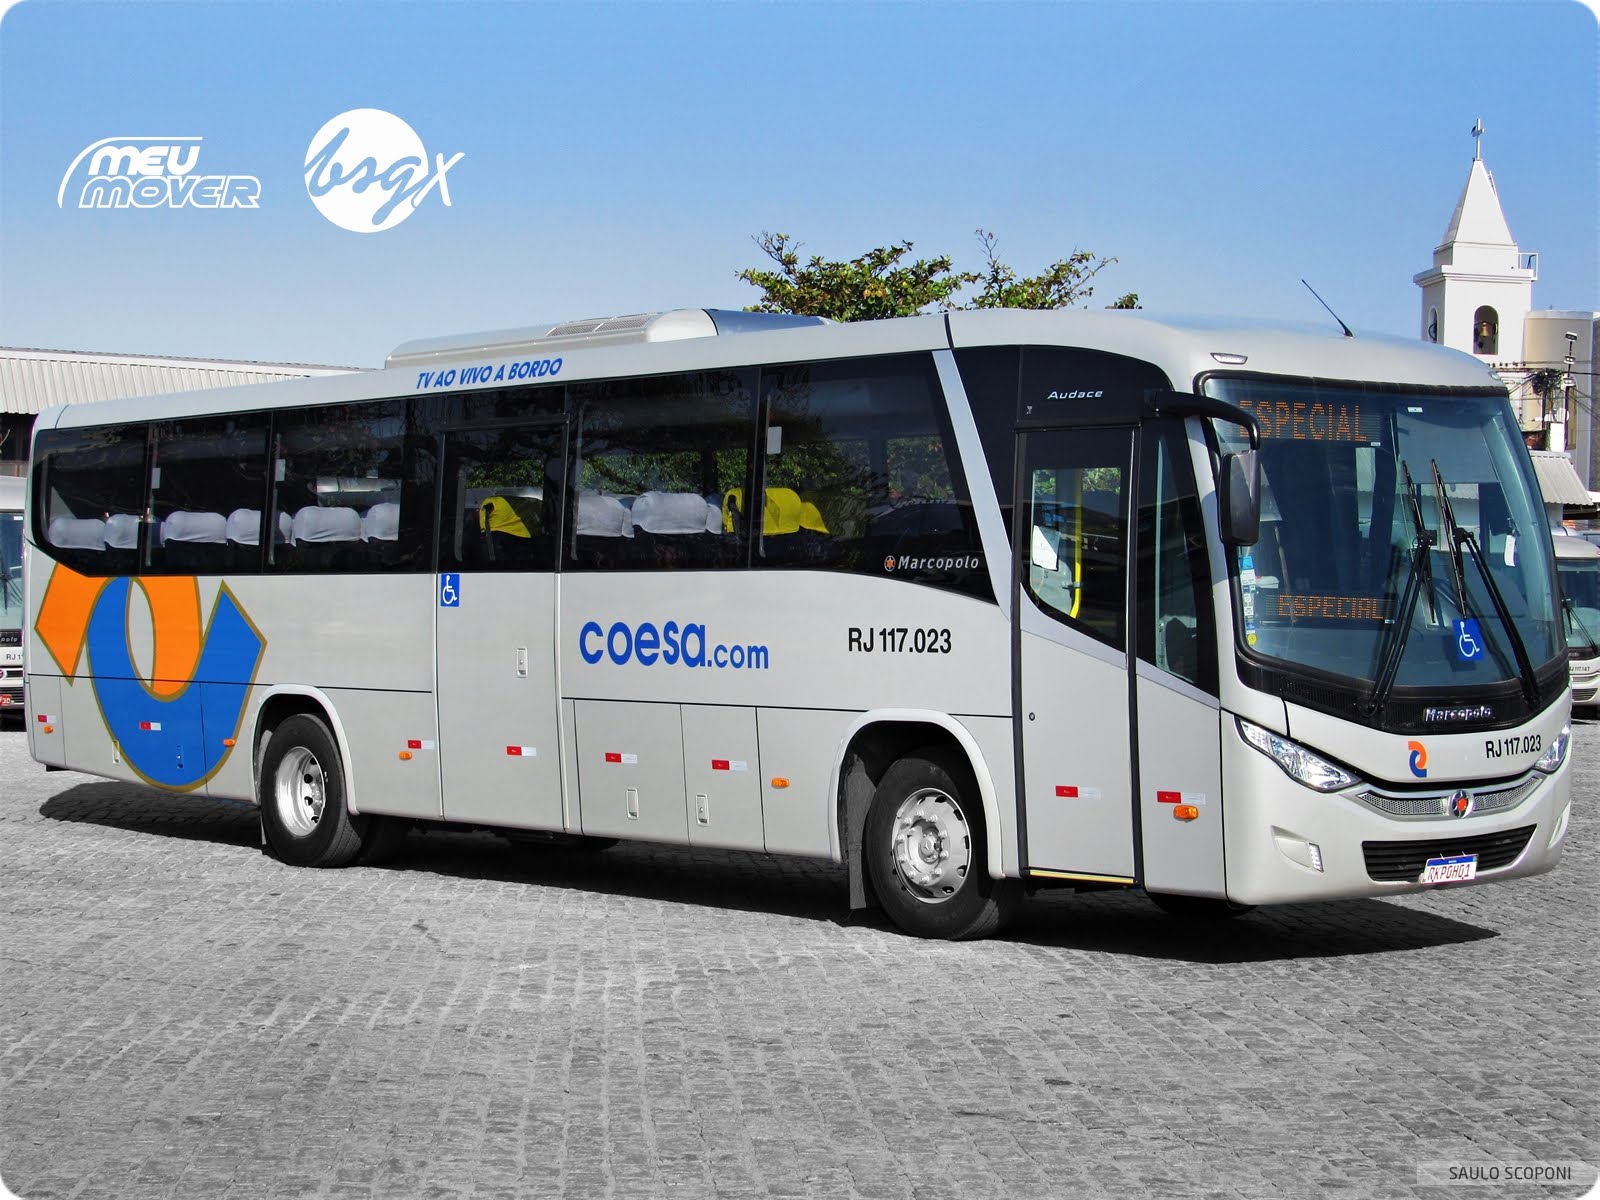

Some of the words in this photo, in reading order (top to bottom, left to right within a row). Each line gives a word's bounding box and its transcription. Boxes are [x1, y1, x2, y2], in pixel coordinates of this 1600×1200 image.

[416, 371, 435, 389] TV
[433, 369, 457, 388] AO
[459, 365, 493, 385] VIVO
[493, 364, 506, 382] A
[508, 357, 563, 380] BORDO
[1047, 390, 1104, 400] Audace
[1239, 400, 1367, 441] ESPECIAL
[898, 555, 979, 571] Marcopolo
[1278, 594, 1384, 619] ESPECIAL
[848, 627, 874, 653] RJ
[879, 627, 952, 654] 117.023
[6, 653, 16, 661] RJ
[1425, 705, 1492, 721] Marcopolo
[1485, 739, 1502, 758] RJ
[1504, 734, 1541, 756] 117.023
